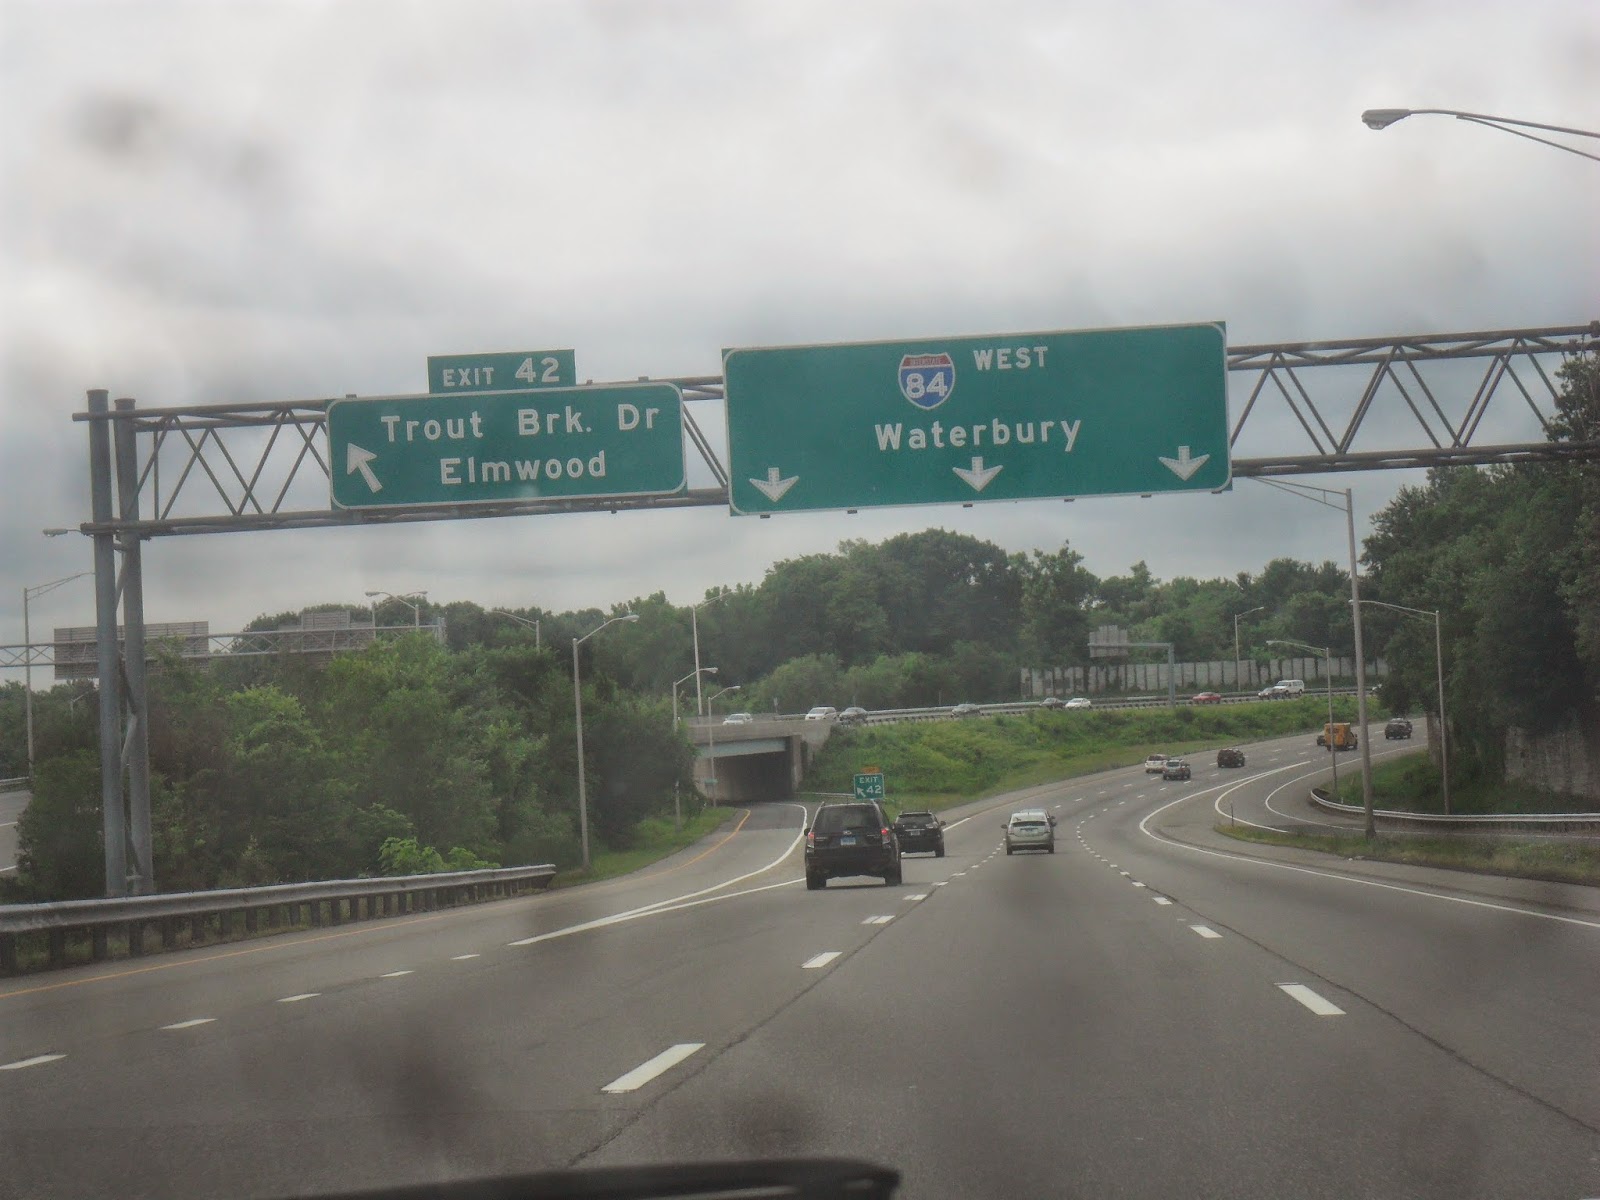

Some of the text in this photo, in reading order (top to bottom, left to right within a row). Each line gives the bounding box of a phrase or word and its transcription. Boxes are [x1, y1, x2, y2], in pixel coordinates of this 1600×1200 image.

[973, 347, 1048, 370] WEST
[442, 358, 560, 387] EXIT 42
[906, 372, 947, 398] 84
[381, 404, 659, 442] Trout Brk. Dr
[875, 418, 1081, 452] Waterbury
[440, 451, 606, 485] Elmwood
[859, 776, 878, 784] EXIT
[866, 785, 882, 794] 42
